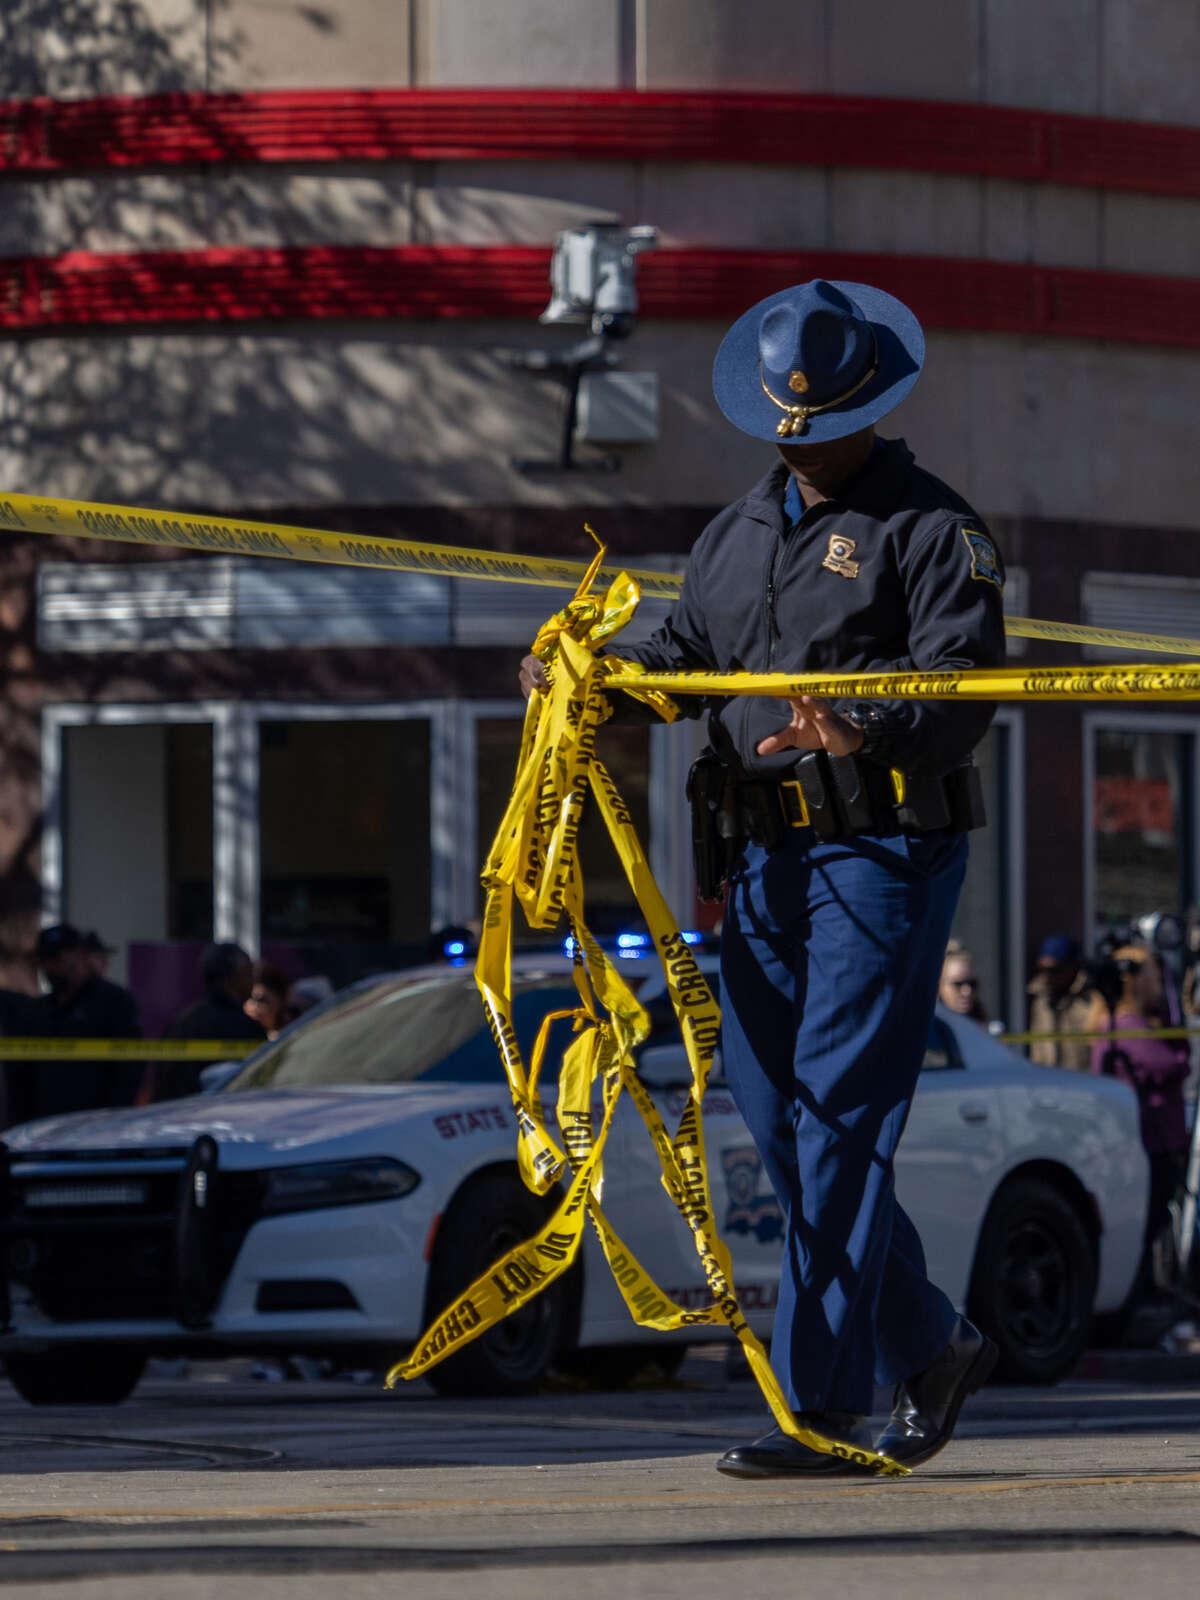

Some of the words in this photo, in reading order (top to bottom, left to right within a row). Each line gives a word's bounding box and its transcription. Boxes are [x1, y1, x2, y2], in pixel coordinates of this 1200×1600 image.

[662, 932, 711, 1008] CROSS
[535, 1231, 577, 1262] DO
[491, 1253, 546, 1304] NOT
